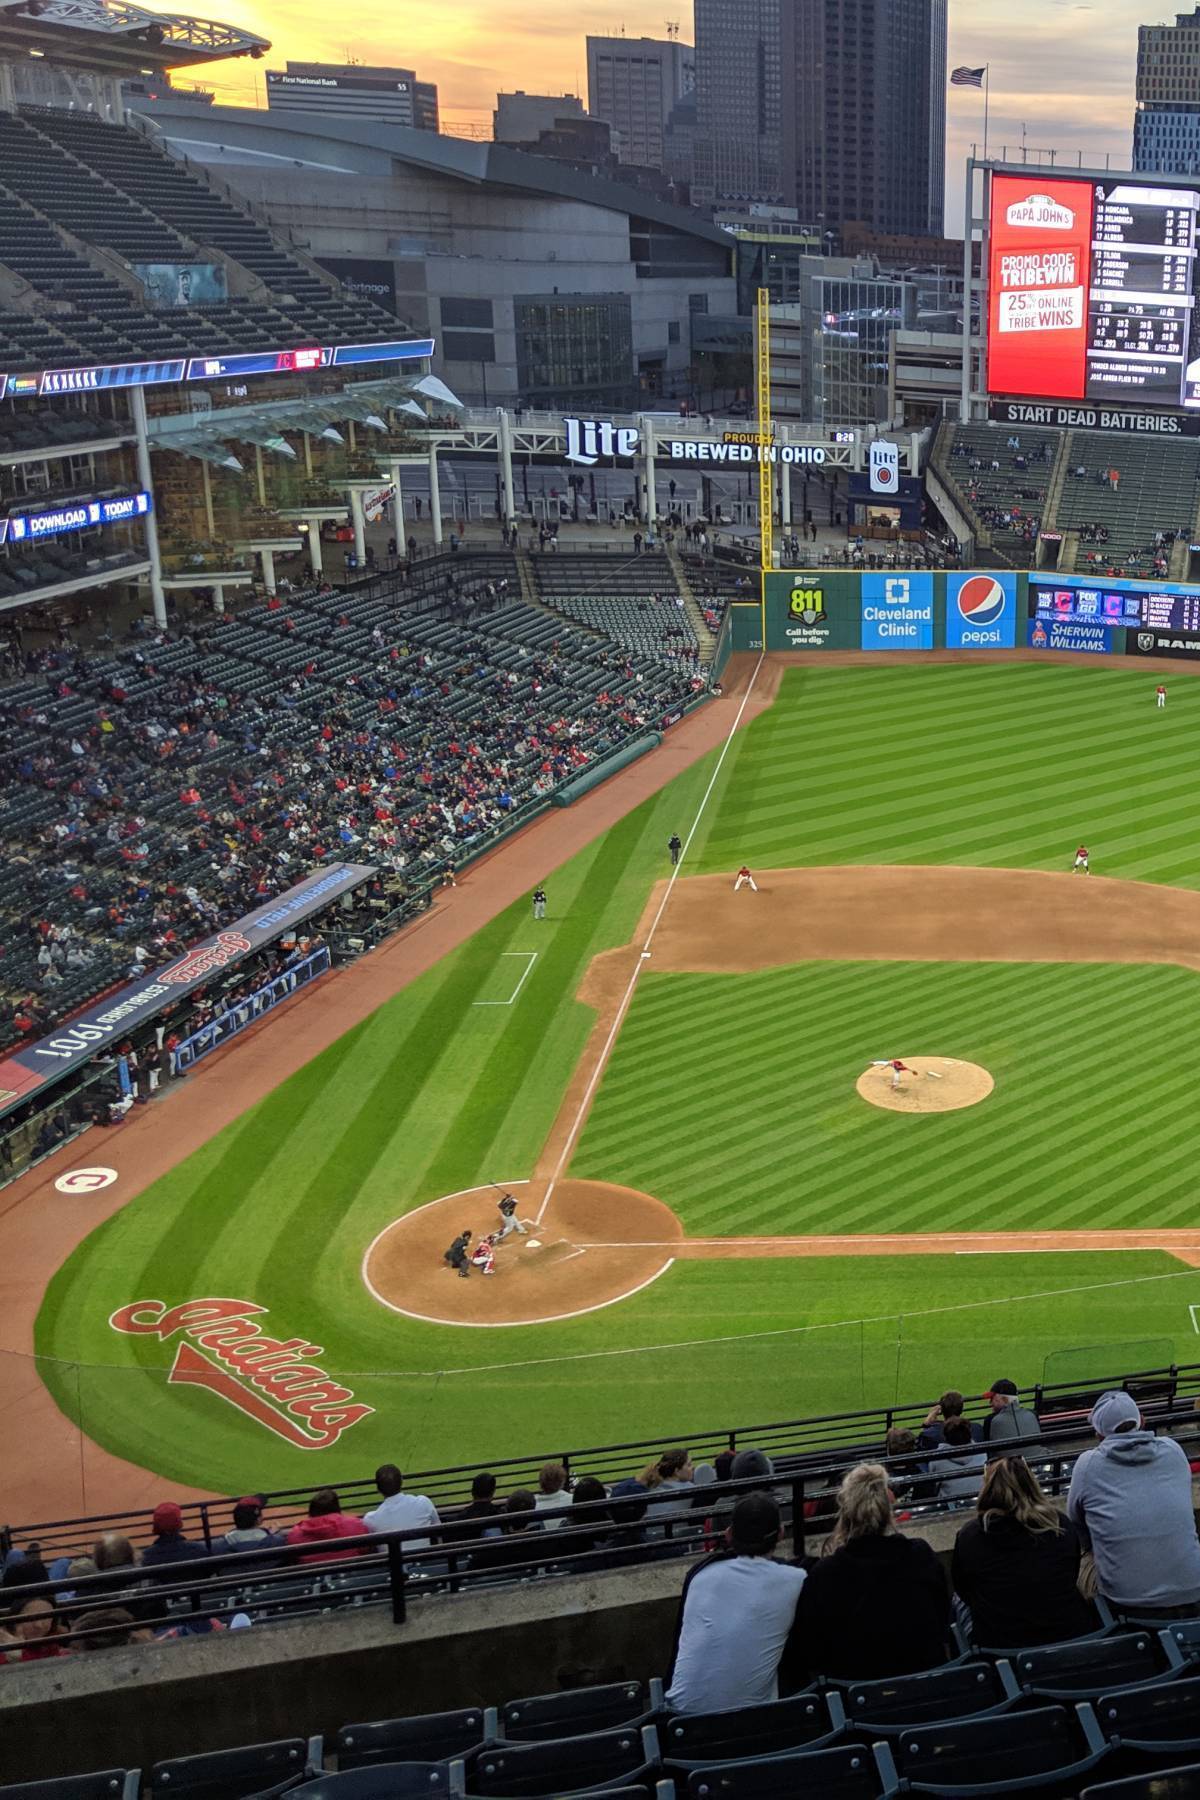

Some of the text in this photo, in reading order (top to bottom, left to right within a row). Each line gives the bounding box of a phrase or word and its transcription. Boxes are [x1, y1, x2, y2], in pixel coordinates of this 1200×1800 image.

[282, 76, 337, 87] First National Bank
[1011, 208, 1034, 221] PAPA
[1001, 252, 1075, 271] PROMO CODE:
[1001, 264, 1075, 287] TRIBEWIN
[1008, 294, 1026, 310] 25
[1038, 296, 1073, 309] ONLINE
[1008, 310, 1073, 329] TRIBE WINS
[1008, 405, 1182, 433] START DEAD BATTERIES.
[563, 417, 639, 464] Lite
[724, 432, 774, 444] PROUDY
[671, 442, 826, 464] BREWED IN OHIO
[873, 450, 897, 466] Lite
[104, 500, 134, 516] TODAY
[31, 510, 86, 532] DOWNLOAD
[792, 590, 822, 612] 811
[863, 606, 931, 621] Cleveland
[786, 628, 830, 636] Call before
[878, 623, 917, 637] Clinic
[962, 631, 1000, 644] pepsi
[1051, 622, 1104, 638] SHERWIN
[792, 636, 825, 645] you dig.
[1050, 636, 1106, 651] WILLIAMS.
[36, 984, 169, 1058] ESTABLISHED 1901
[66, 1173, 108, 1188] C
[109, 1298, 376, 1440] Indians
